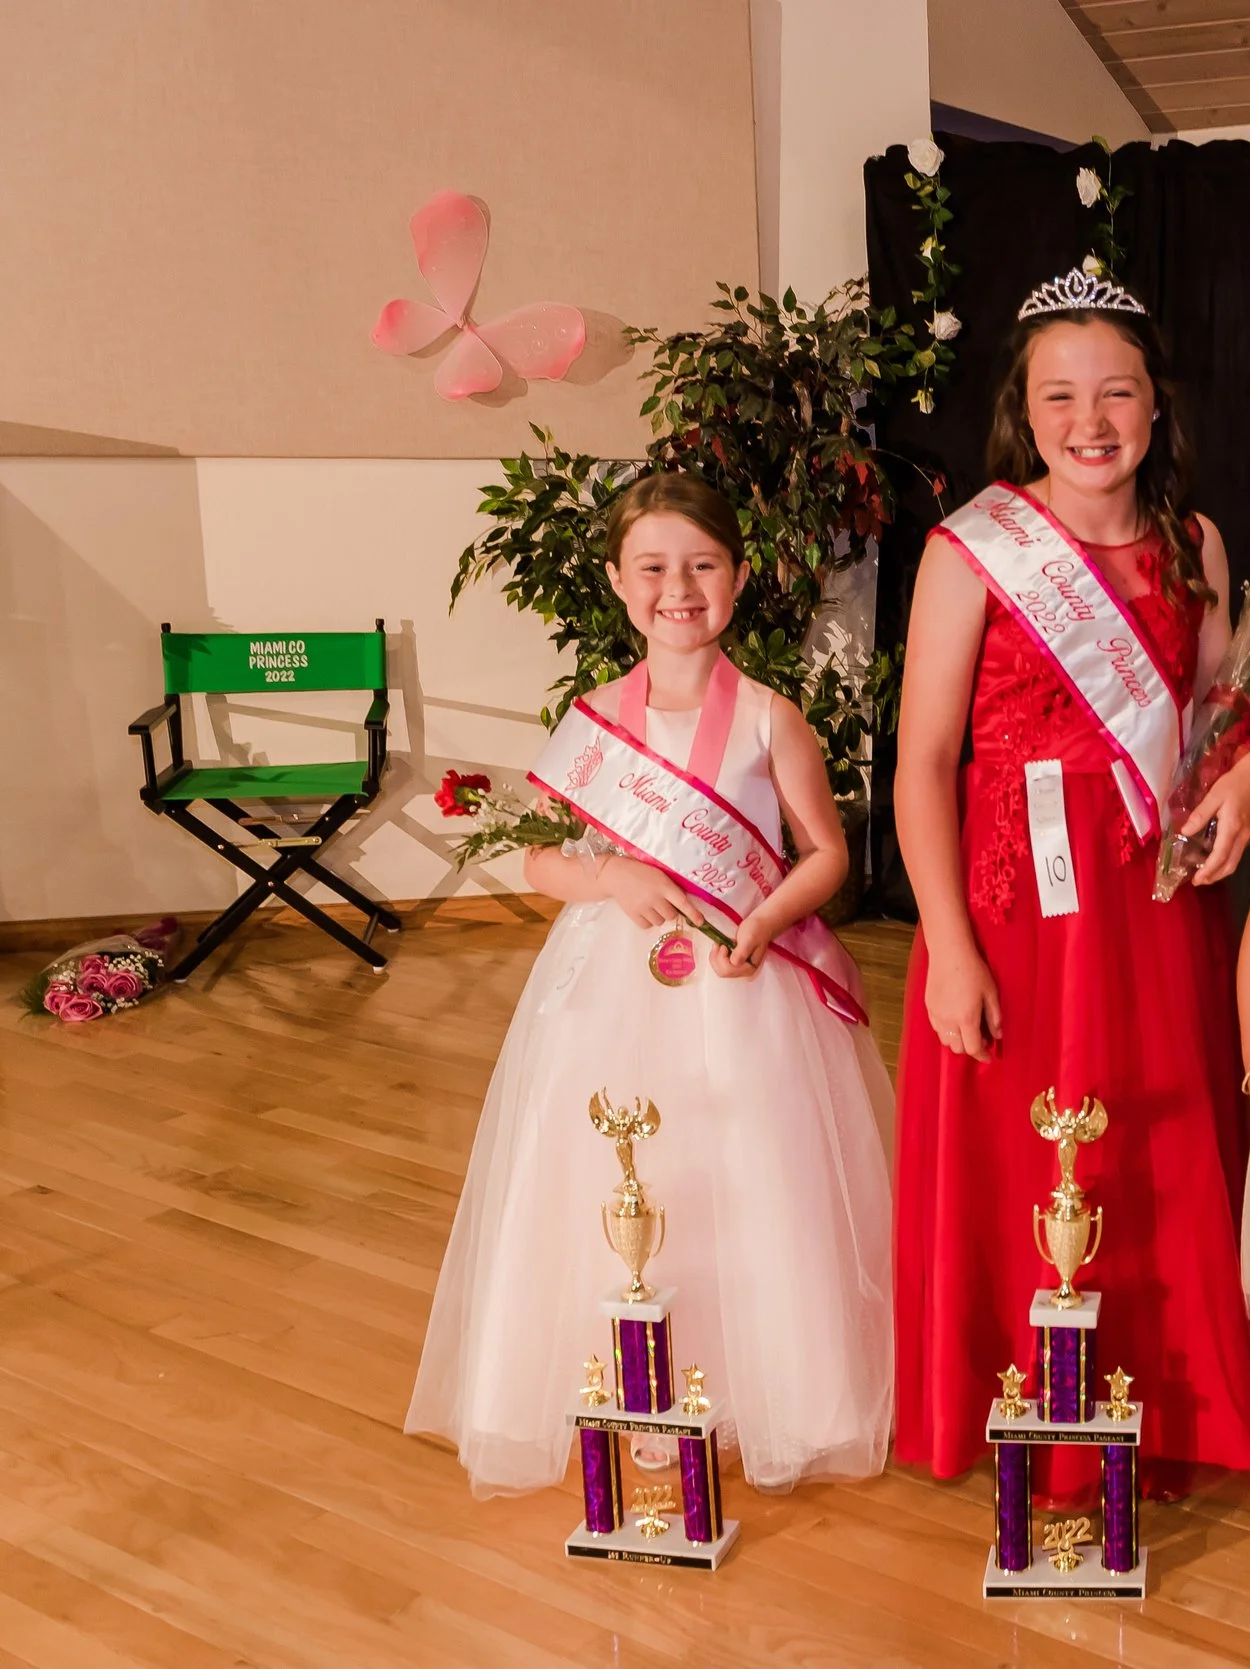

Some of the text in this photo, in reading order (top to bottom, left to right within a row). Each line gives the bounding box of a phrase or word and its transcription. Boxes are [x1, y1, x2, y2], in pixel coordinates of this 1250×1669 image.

[974, 494, 1152, 708] Miami County Princess
[1016, 591, 1066, 634] 2022
[249, 655, 309, 669] PRINCESS
[250, 640, 306, 655] MIAMI CO
[265, 670, 296, 683] 2022
[619, 772, 677, 813] Miami
[682, 808, 732, 857] County
[692, 863, 735, 893] 2022
[1044, 855, 1067, 887] 10
[1003, 1431, 1125, 1443] MIAMI COUNTY PRINCESS PAGEANT
[1042, 1516, 1094, 1551] 2022
[1012, 1588, 1117, 1598] MIAMI COUNTY PRINCESS
